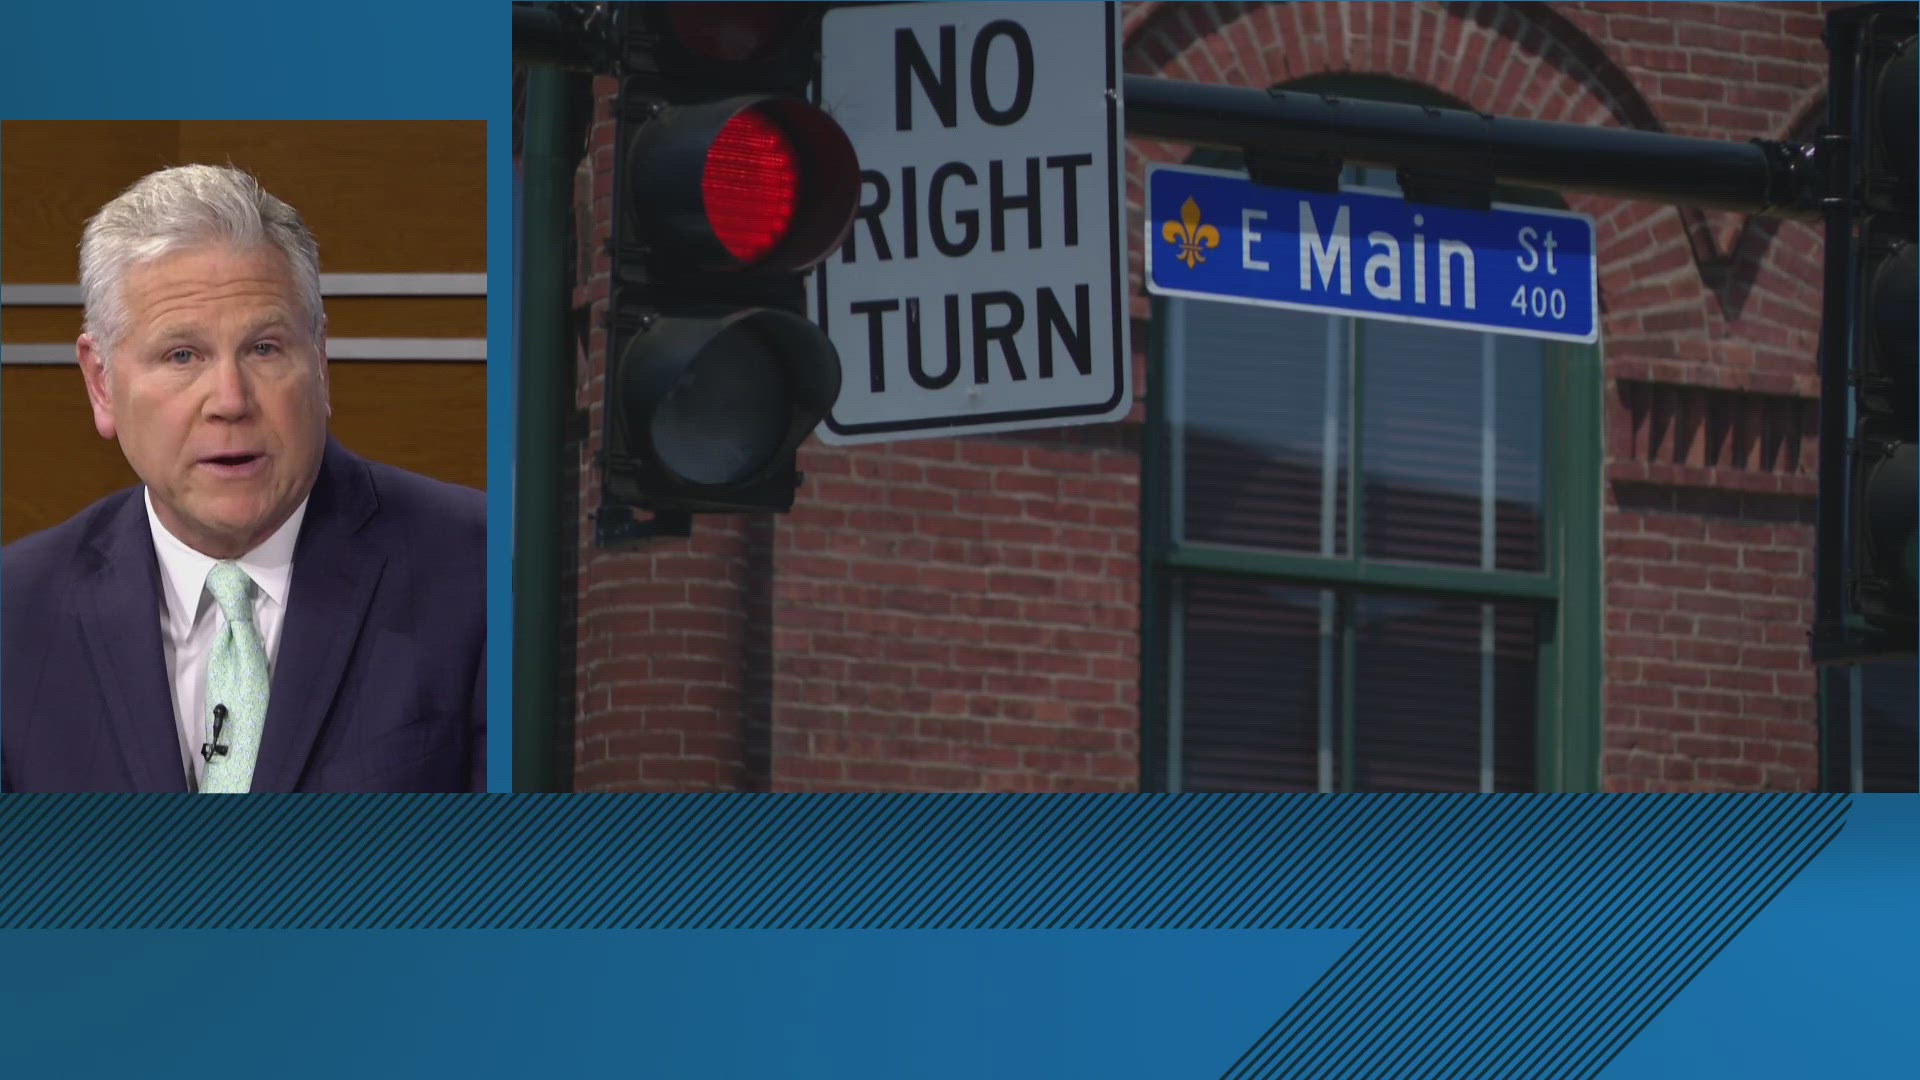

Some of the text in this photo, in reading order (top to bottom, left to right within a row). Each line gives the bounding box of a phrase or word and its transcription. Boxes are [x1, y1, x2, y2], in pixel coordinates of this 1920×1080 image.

[895, 19, 1034, 131] NO
[842, 153, 1092, 264] RIGHT
[1241, 200, 1558, 309] E Main St
[850, 283, 1092, 393] TURN
[1511, 285, 1566, 320] 400
